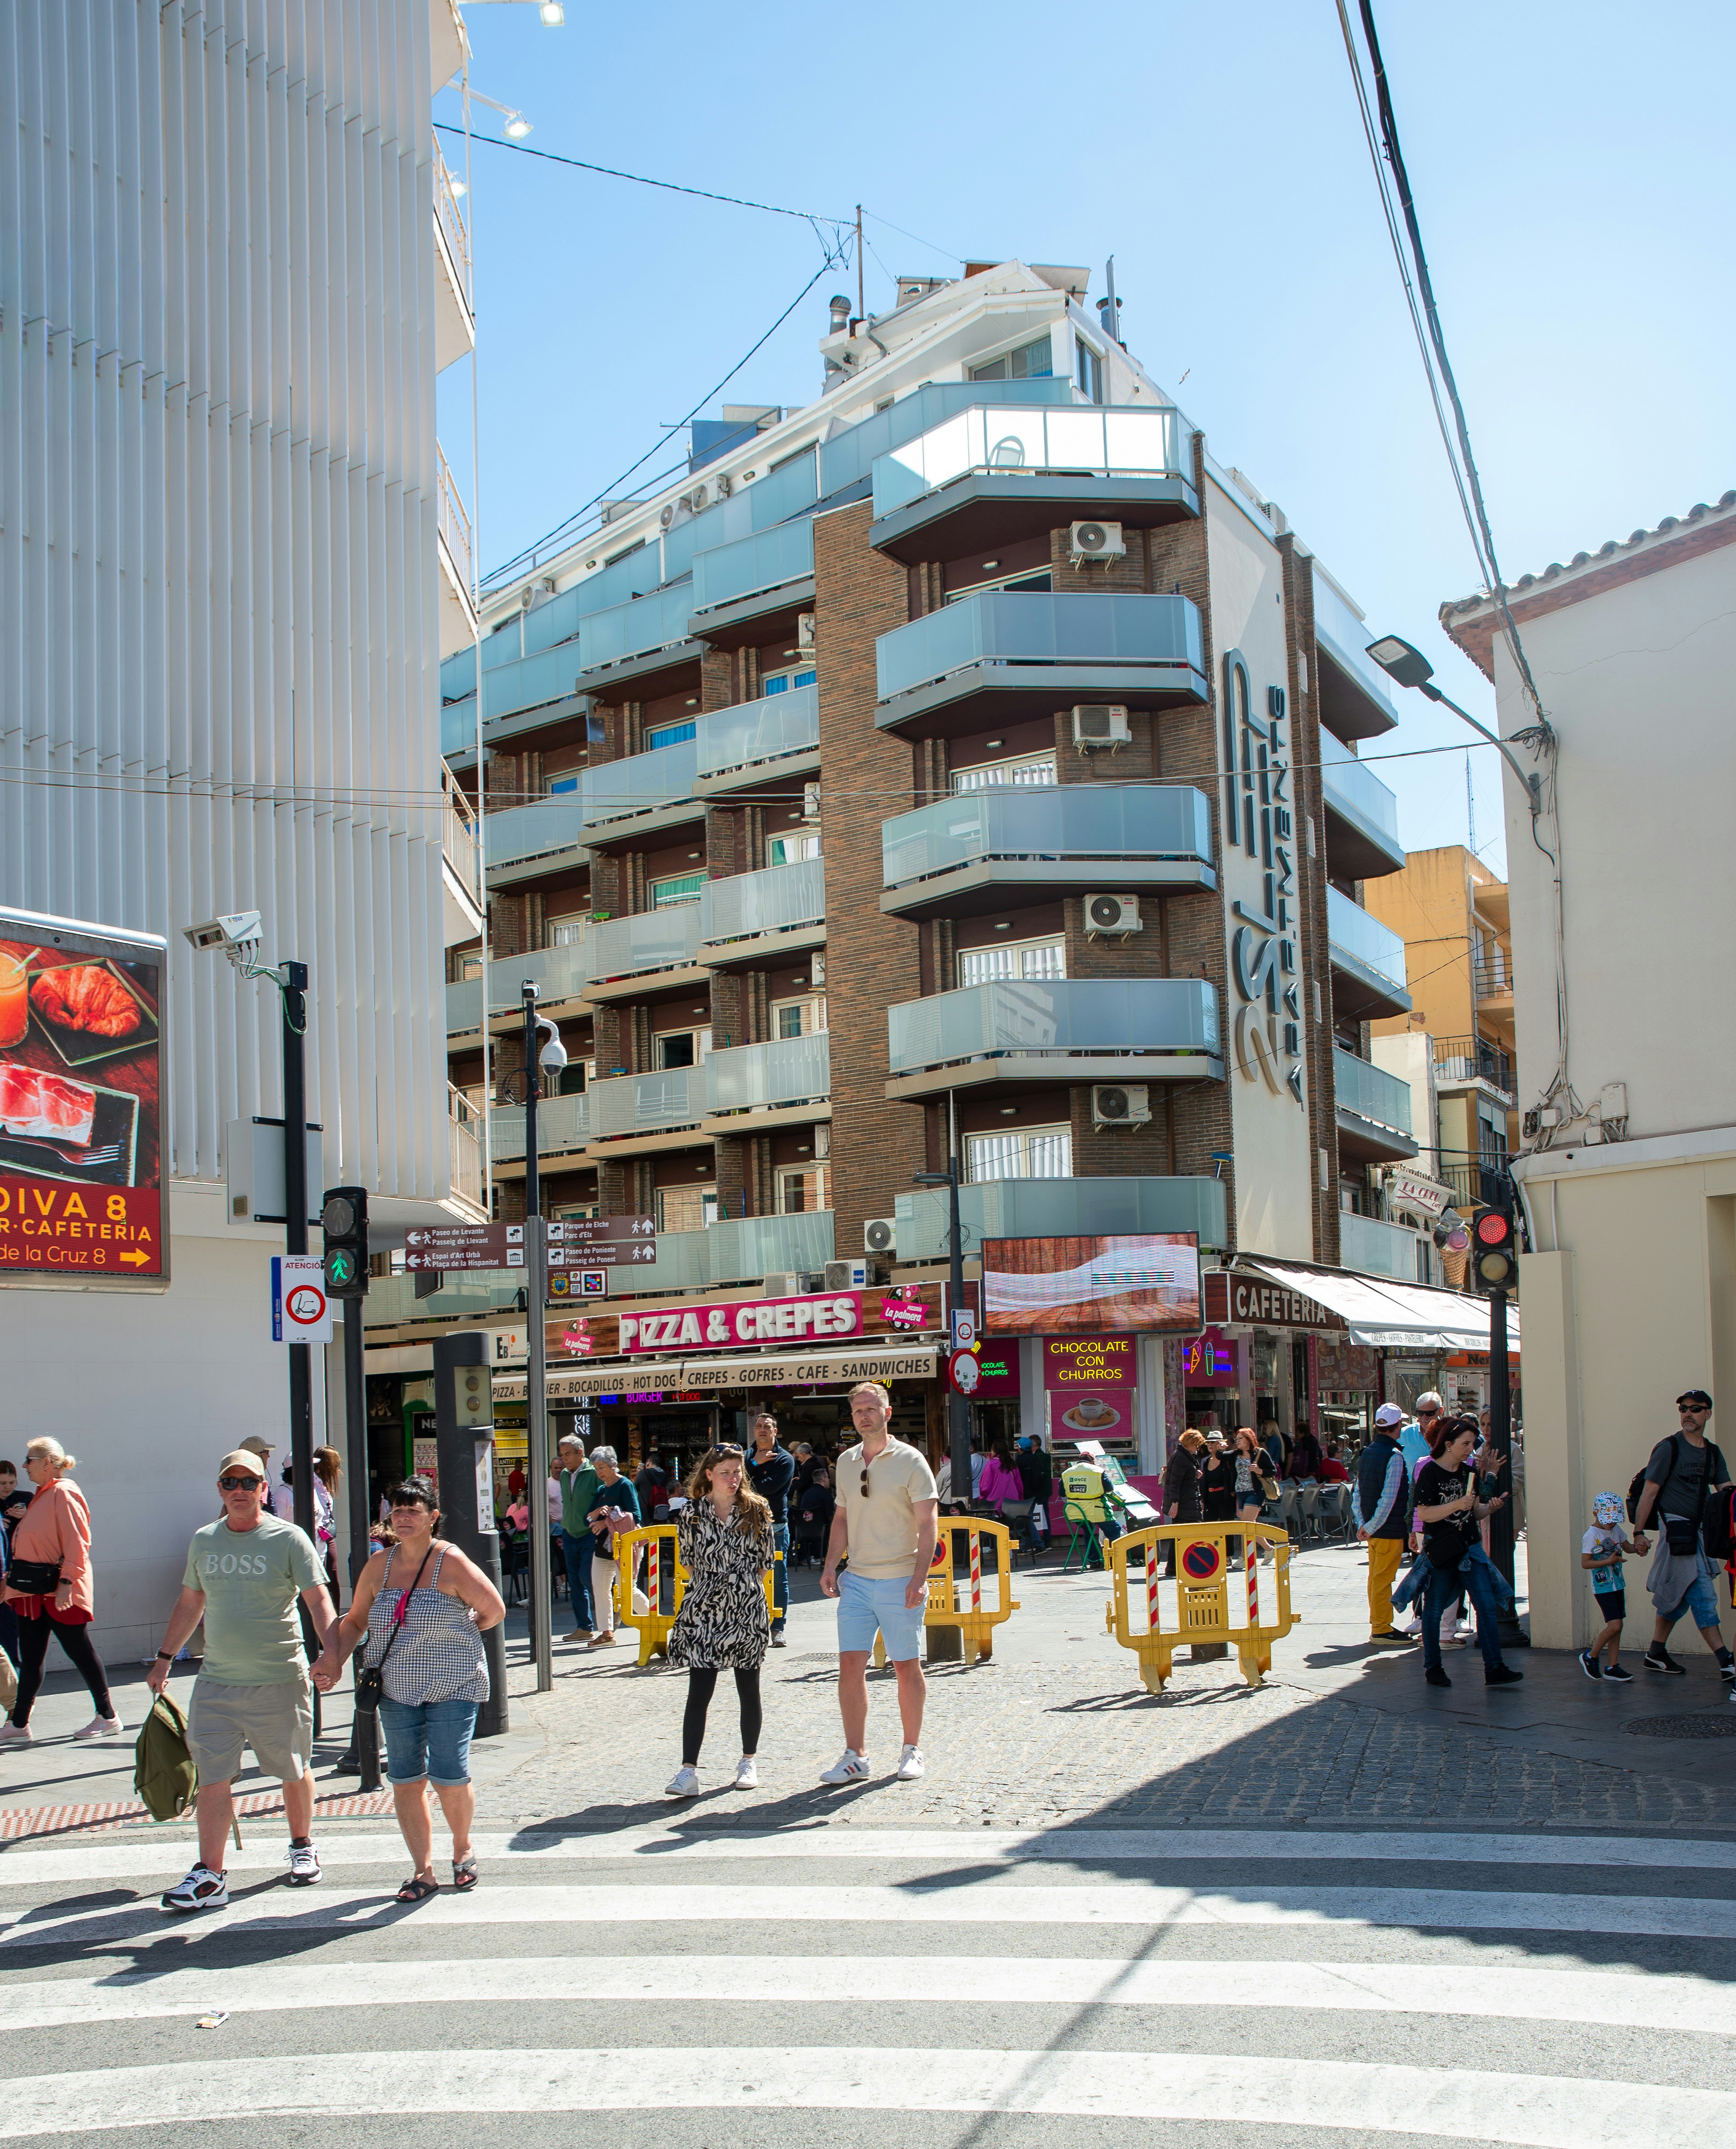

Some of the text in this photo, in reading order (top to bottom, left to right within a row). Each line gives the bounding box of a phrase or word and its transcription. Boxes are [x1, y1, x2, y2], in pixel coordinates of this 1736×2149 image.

[1268, 683, 1305, 1113] APARTMENTS
[1403, 1182, 1415, 1194] LA
[106, 1195, 126, 1221] 8
[0, 1243, 105, 1264] de la Cruz 8
[1236, 1285, 1327, 1323] CAFETERIA
[621, 1297, 857, 1349] PIZZA & CREPES
[885, 1307, 922, 1323] La palmera
[565, 1338, 571, 1347] La
[570, 1340, 590, 1351] palmera
[1371, 1332, 1386, 1342] CREPES
[1050, 1341, 1129, 1353] CHOCOLATE
[1077, 1356, 1104, 1366] CON
[687, 1359, 931, 1385] CREPES GOFRES CAFE SANDWICHES
[1059, 1368, 1123, 1381] CHURROS
[493, 1386, 515, 1398] PIZZA
[568, 1378, 624, 1393] BOCADILLOS
[633, 1375, 651, 1389] HOT
[655, 1374, 676, 1387] DOG
[626, 1391, 663, 1403] BURGER
[687, 1392, 701, 1402] DOG
[204, 1553, 267, 1574] BOSS
